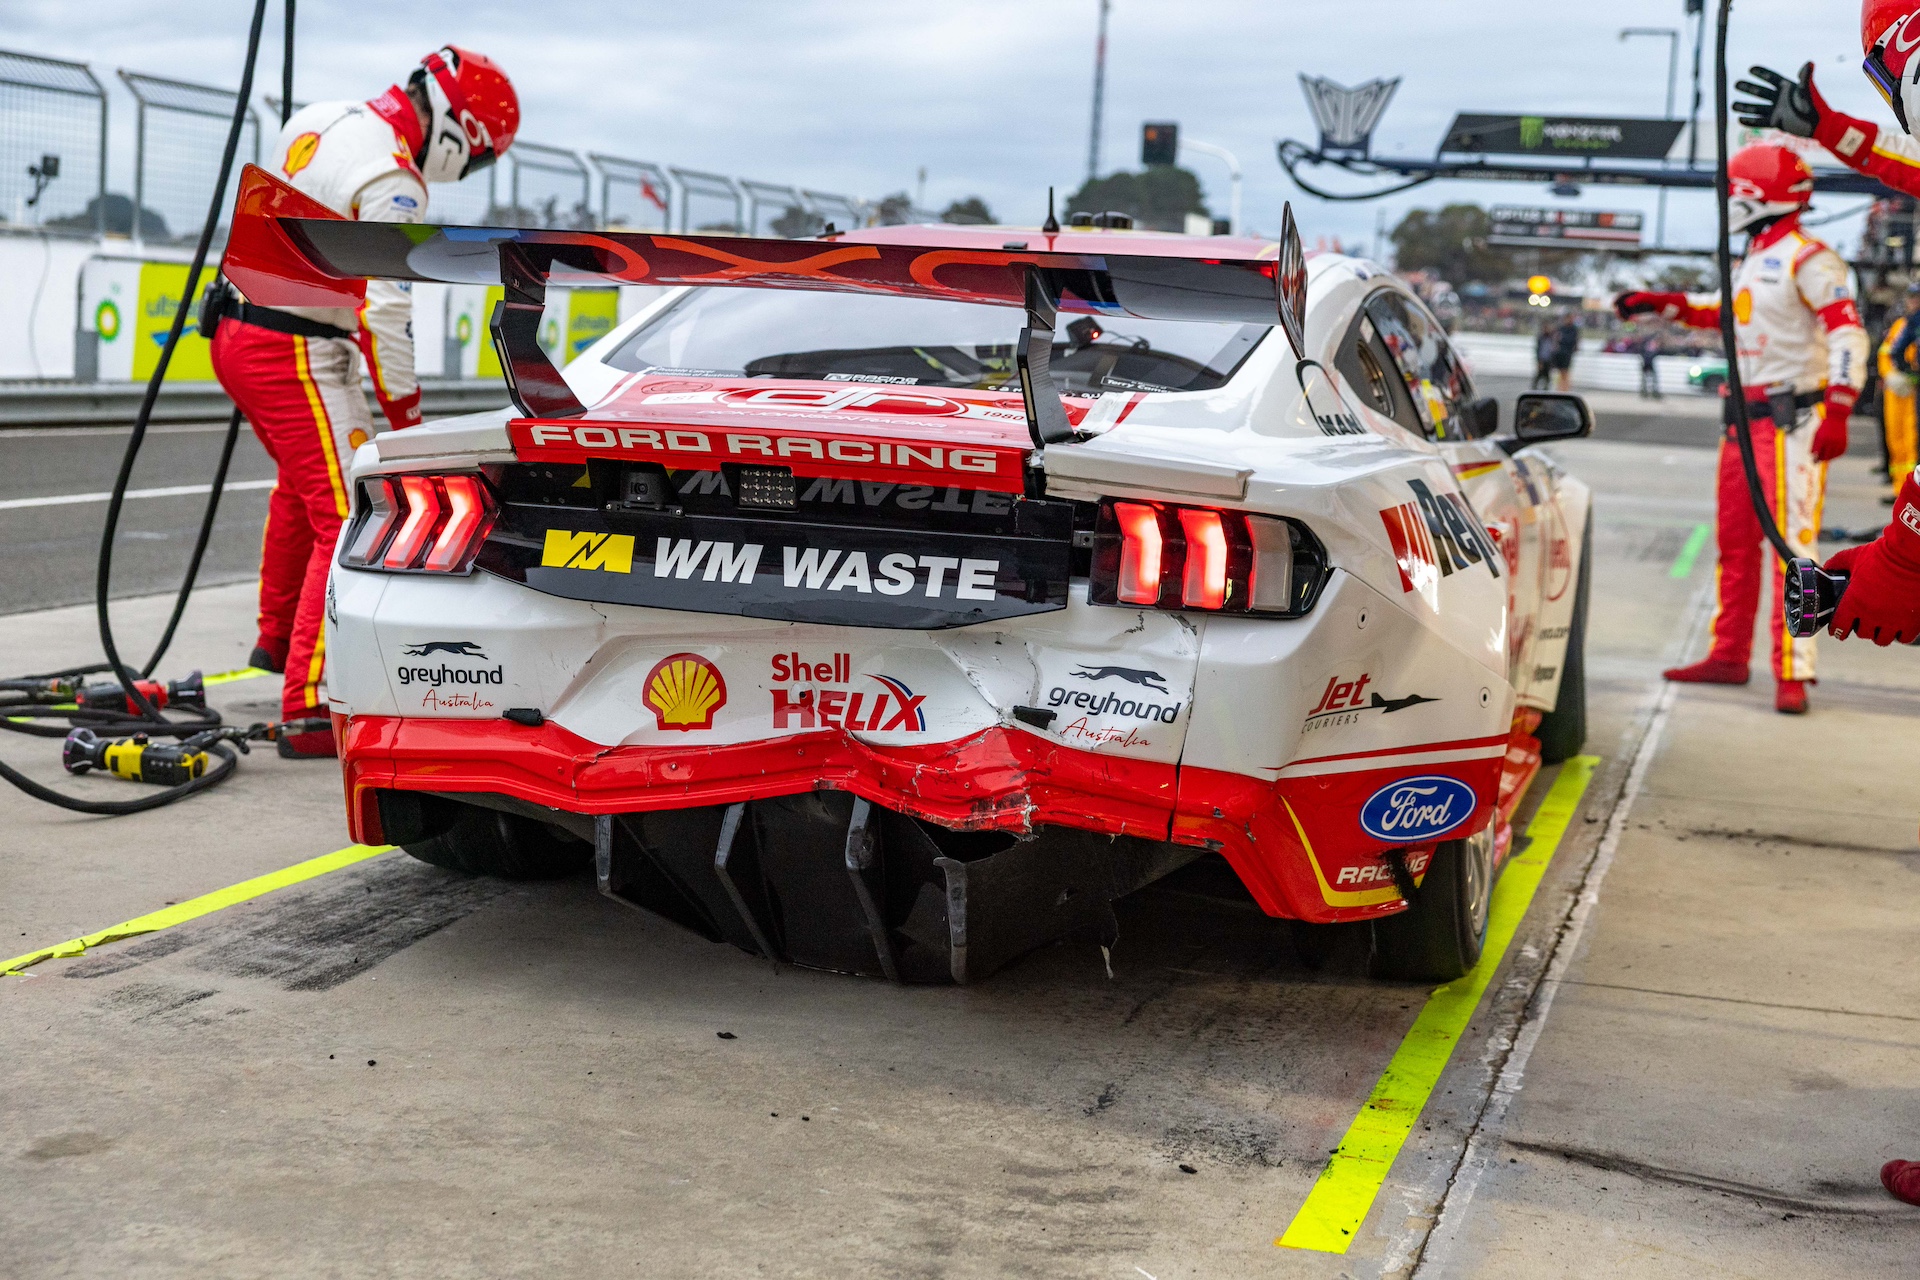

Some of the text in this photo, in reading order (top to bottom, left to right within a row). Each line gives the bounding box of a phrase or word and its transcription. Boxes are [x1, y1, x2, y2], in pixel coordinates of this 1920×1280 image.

[983, 410, 1025, 421] 1980
[530, 425, 997, 473] FORD RACING
[654, 537, 1000, 601] WM WASTE
[398, 664, 503, 687] greyhound
[771, 652, 850, 683] Shell
[422, 689, 494, 711] Australia
[769, 674, 927, 732] HELIX
[1048, 687, 1182, 724] greyhound
[1308, 673, 1371, 716] Jet
[1059, 716, 1151, 748] Australia
[1302, 713, 1359, 734] COURIERS
[1381, 786, 1454, 831] Ford
